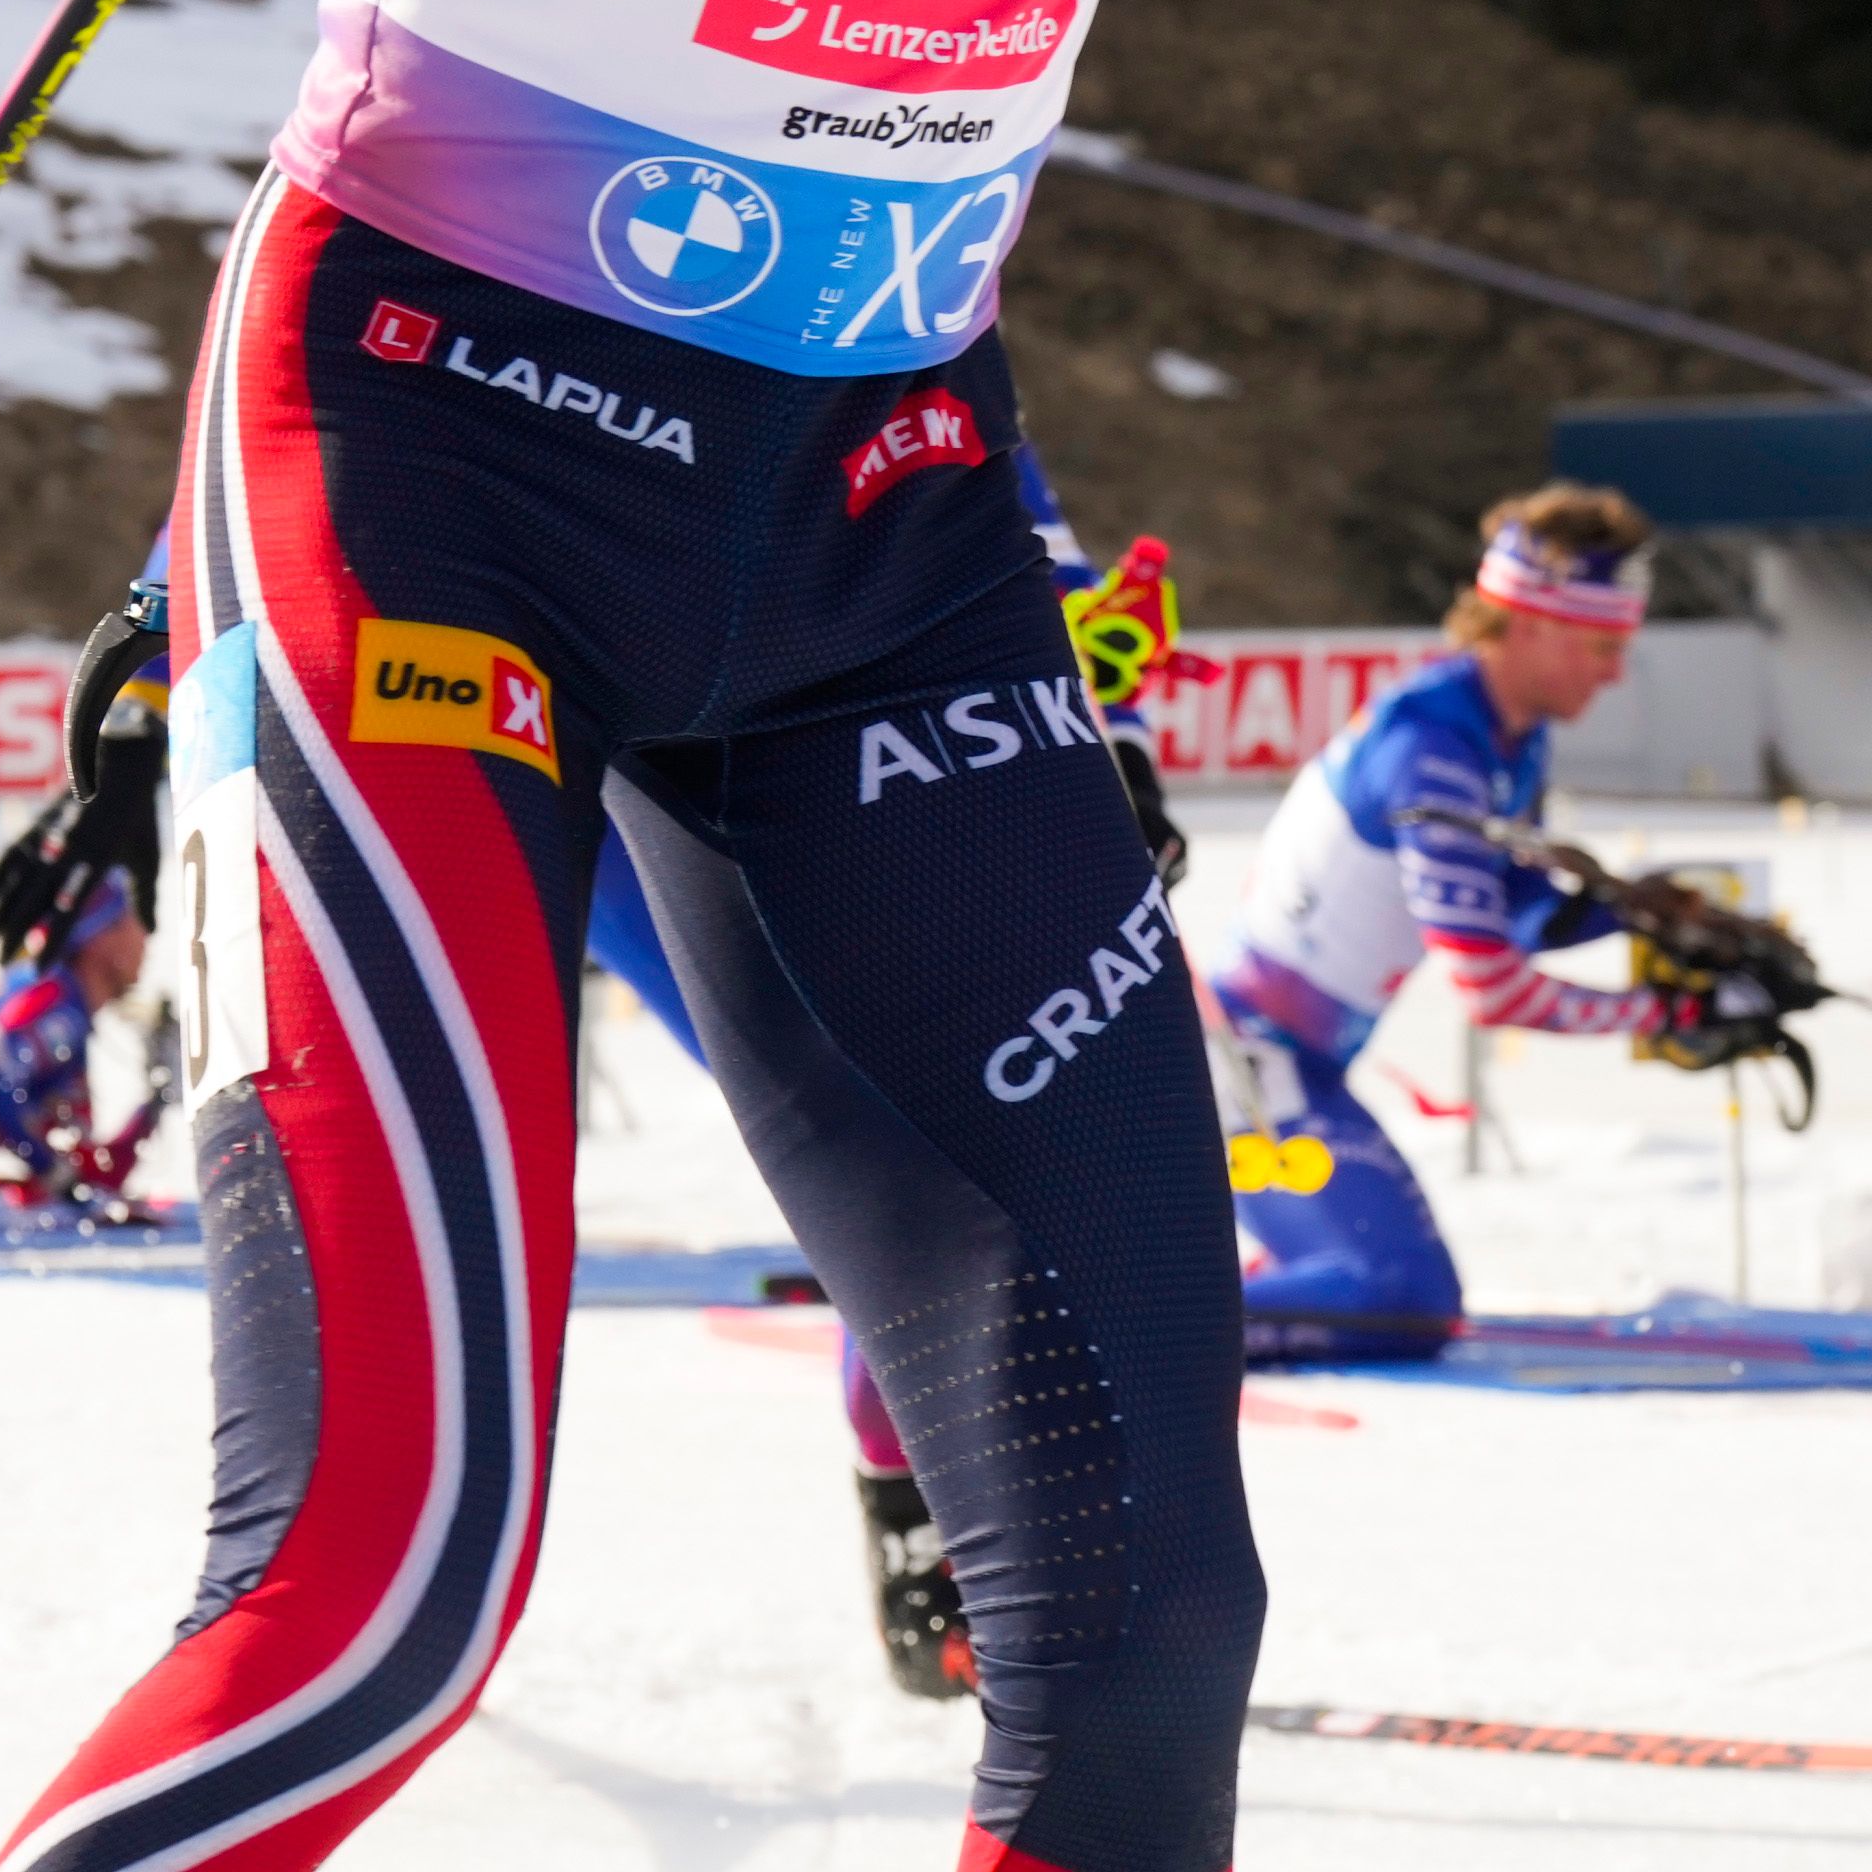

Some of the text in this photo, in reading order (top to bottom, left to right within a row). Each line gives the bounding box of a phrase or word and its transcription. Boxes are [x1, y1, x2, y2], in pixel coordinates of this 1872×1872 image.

[637, 165, 766, 223] BMW
[802, 198, 874, 345] THE NEW
[832, 172, 1021, 348] X3
[445, 337, 696, 465] LAPUA
[376, 661, 481, 707] Uno
[858, 675, 1102, 804] ASK
[984, 874, 1179, 1103] CRAFT
